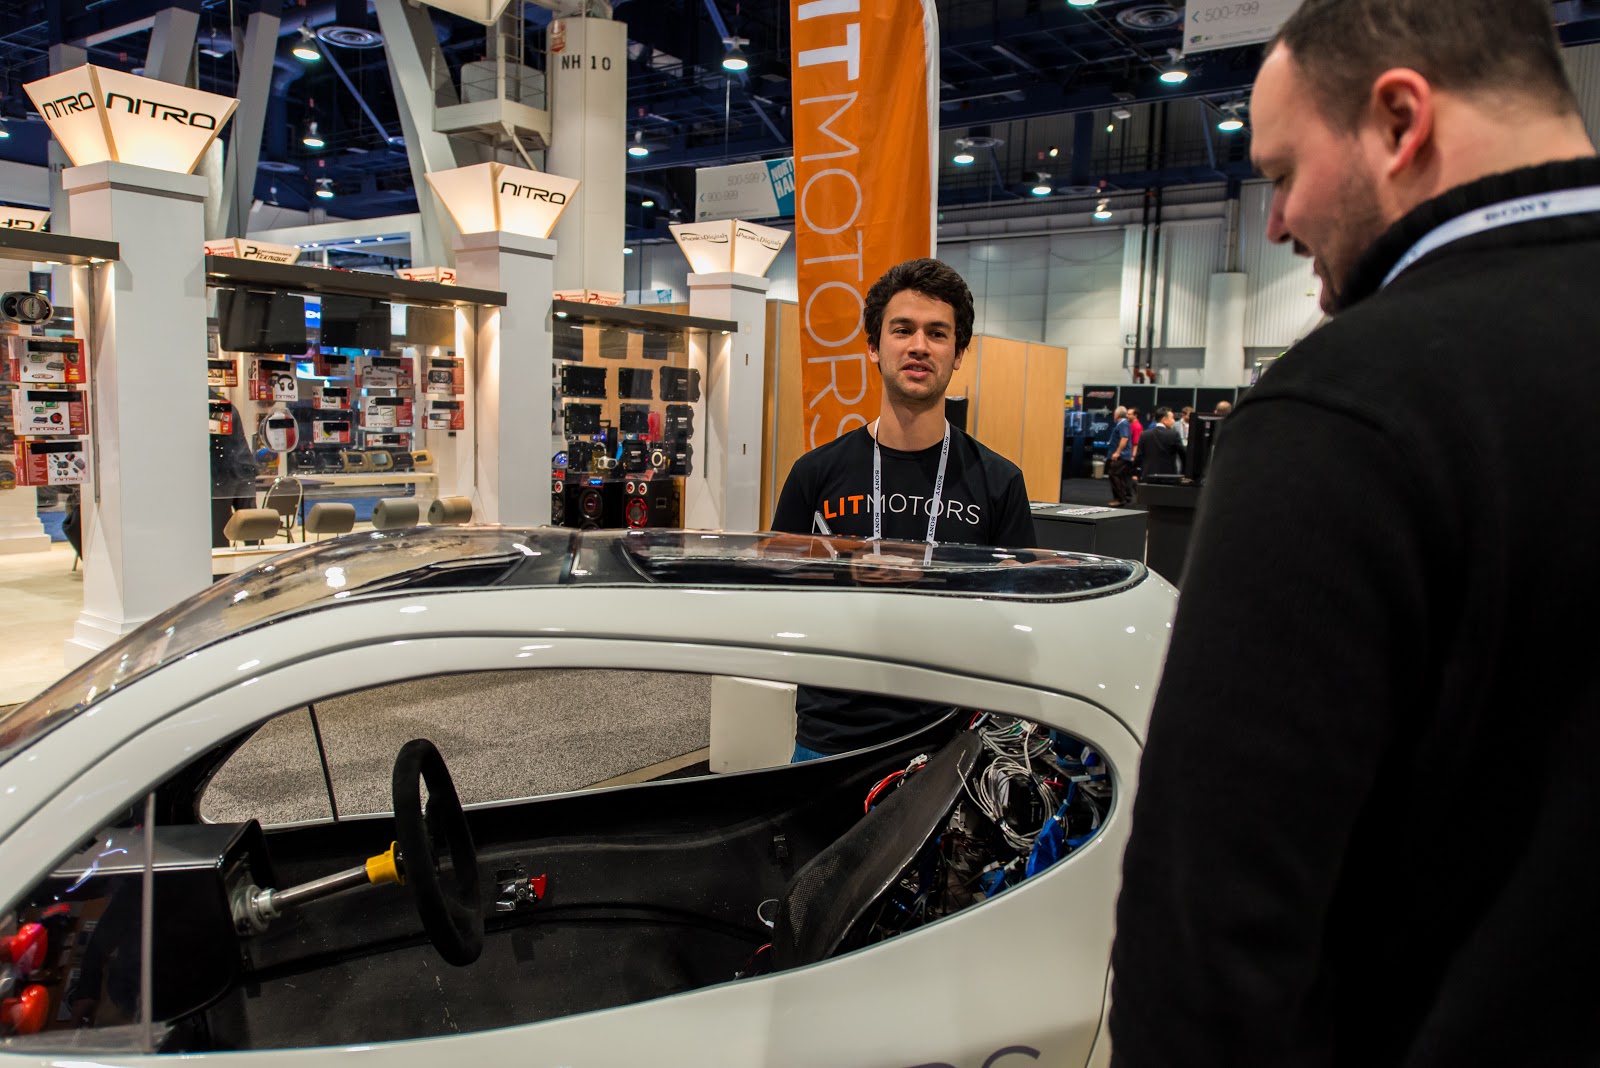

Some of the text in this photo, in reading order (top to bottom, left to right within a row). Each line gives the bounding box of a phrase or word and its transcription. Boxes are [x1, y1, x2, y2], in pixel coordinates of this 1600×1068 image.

[561, 54, 611, 71] NH 10
[42, 91, 95, 120] NITRO
[105, 92, 216, 130] NITRO
[770, 159, 794, 182] NORT
[500, 181, 566, 205] NITRO
